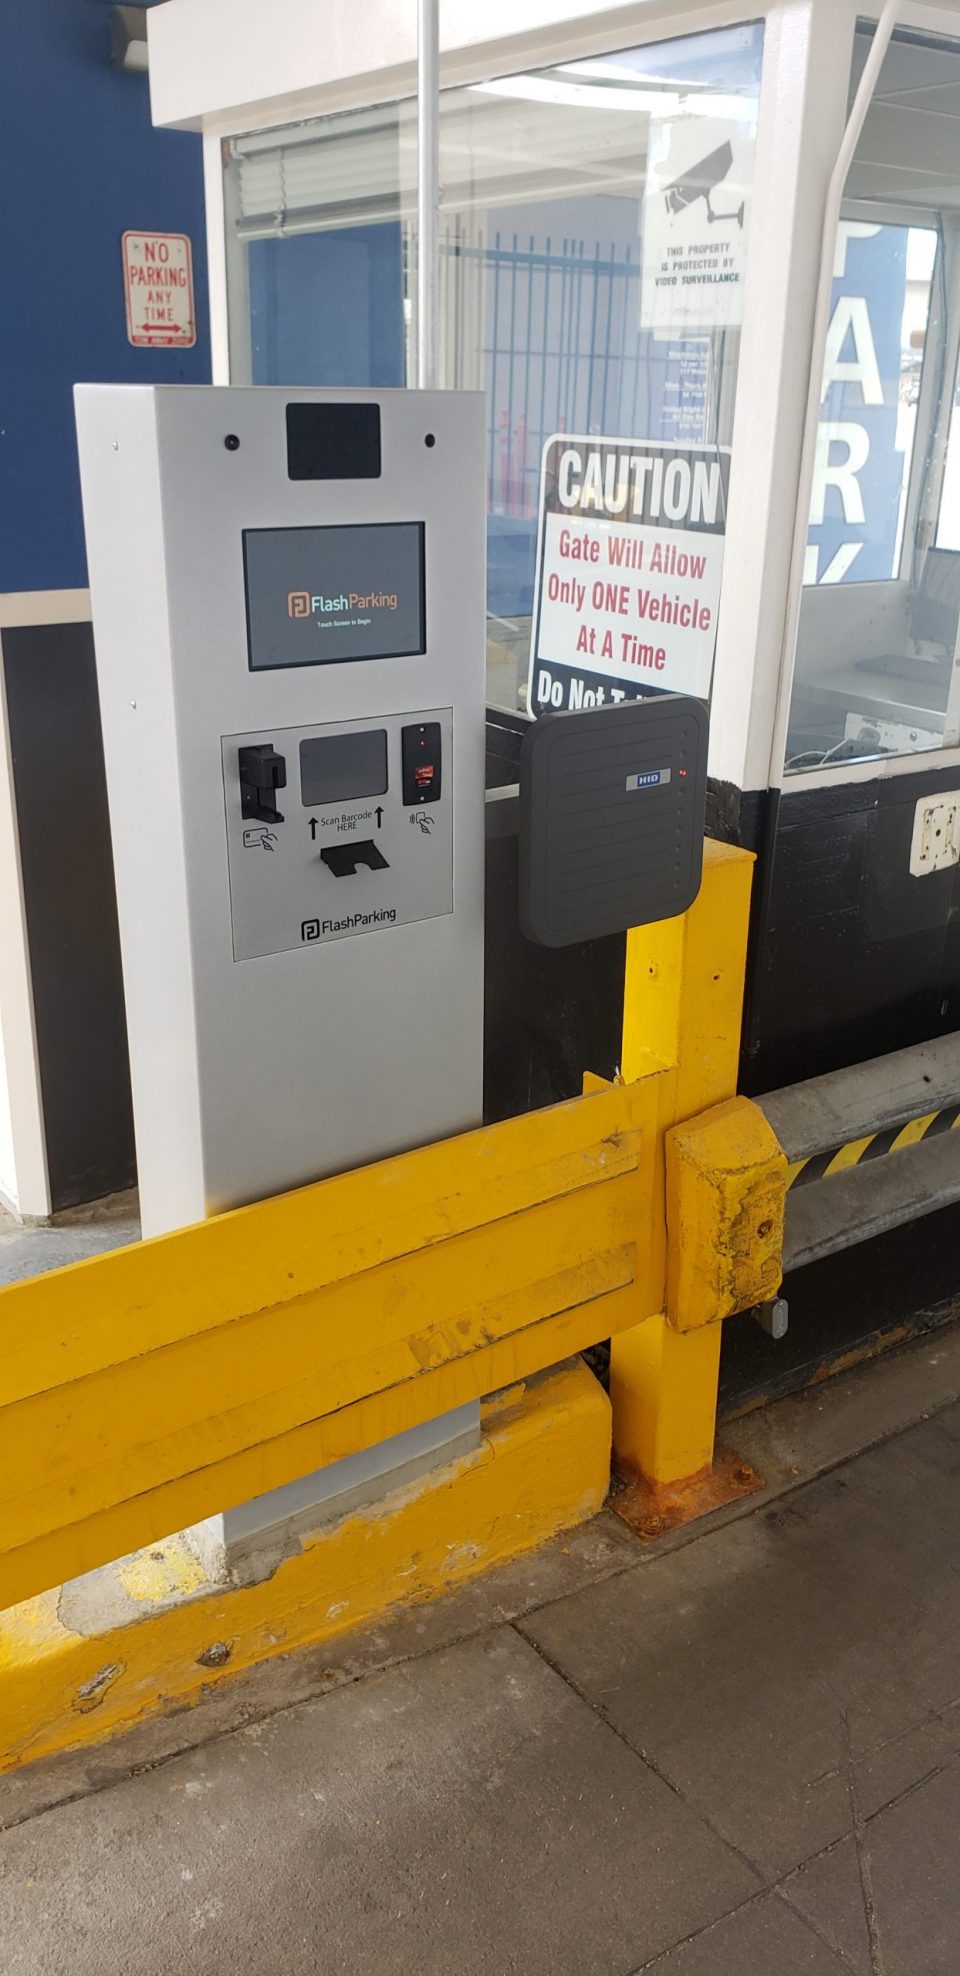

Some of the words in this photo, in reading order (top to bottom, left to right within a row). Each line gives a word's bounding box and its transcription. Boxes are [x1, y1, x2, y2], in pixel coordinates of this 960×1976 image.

[144, 242, 169, 263] NO
[666, 246, 683, 256] THIS
[688, 242, 730, 255] PROPERTY
[661, 262, 668, 272] IS
[673, 259, 718, 271] PROTECTED
[723, 258, 735, 268] BY
[130, 265, 186, 287] PARKING
[655, 276, 677, 286] VIDEO
[681, 273, 740, 285] SURVEILLANCE
[147, 290, 172, 304] ANY
[144, 307, 174, 321] TIME
[558, 450, 721, 524] CAUTION
[559, 529, 600, 563] Gate
[607, 535, 644, 570] Will
[649, 543, 706, 579] Allow
[311, 592, 397, 613] FlashParking
[548, 573, 586, 612] Only
[592, 581, 630, 615] ONE
[637, 588, 711, 631] Vehicle
[357, 618, 371, 626] Begin
[576, 625, 597, 654] At
[601, 630, 613, 659] A
[621, 633, 666, 671] Time
[537, 670, 563, 708] Do
[568, 678, 605, 710] Not
[639, 774, 659, 785] HID
[321, 817, 340, 827] Scan
[341, 810, 373, 823] Barcode
[337, 821, 357, 832] HERE
[322, 908, 396, 934] FlashParking
